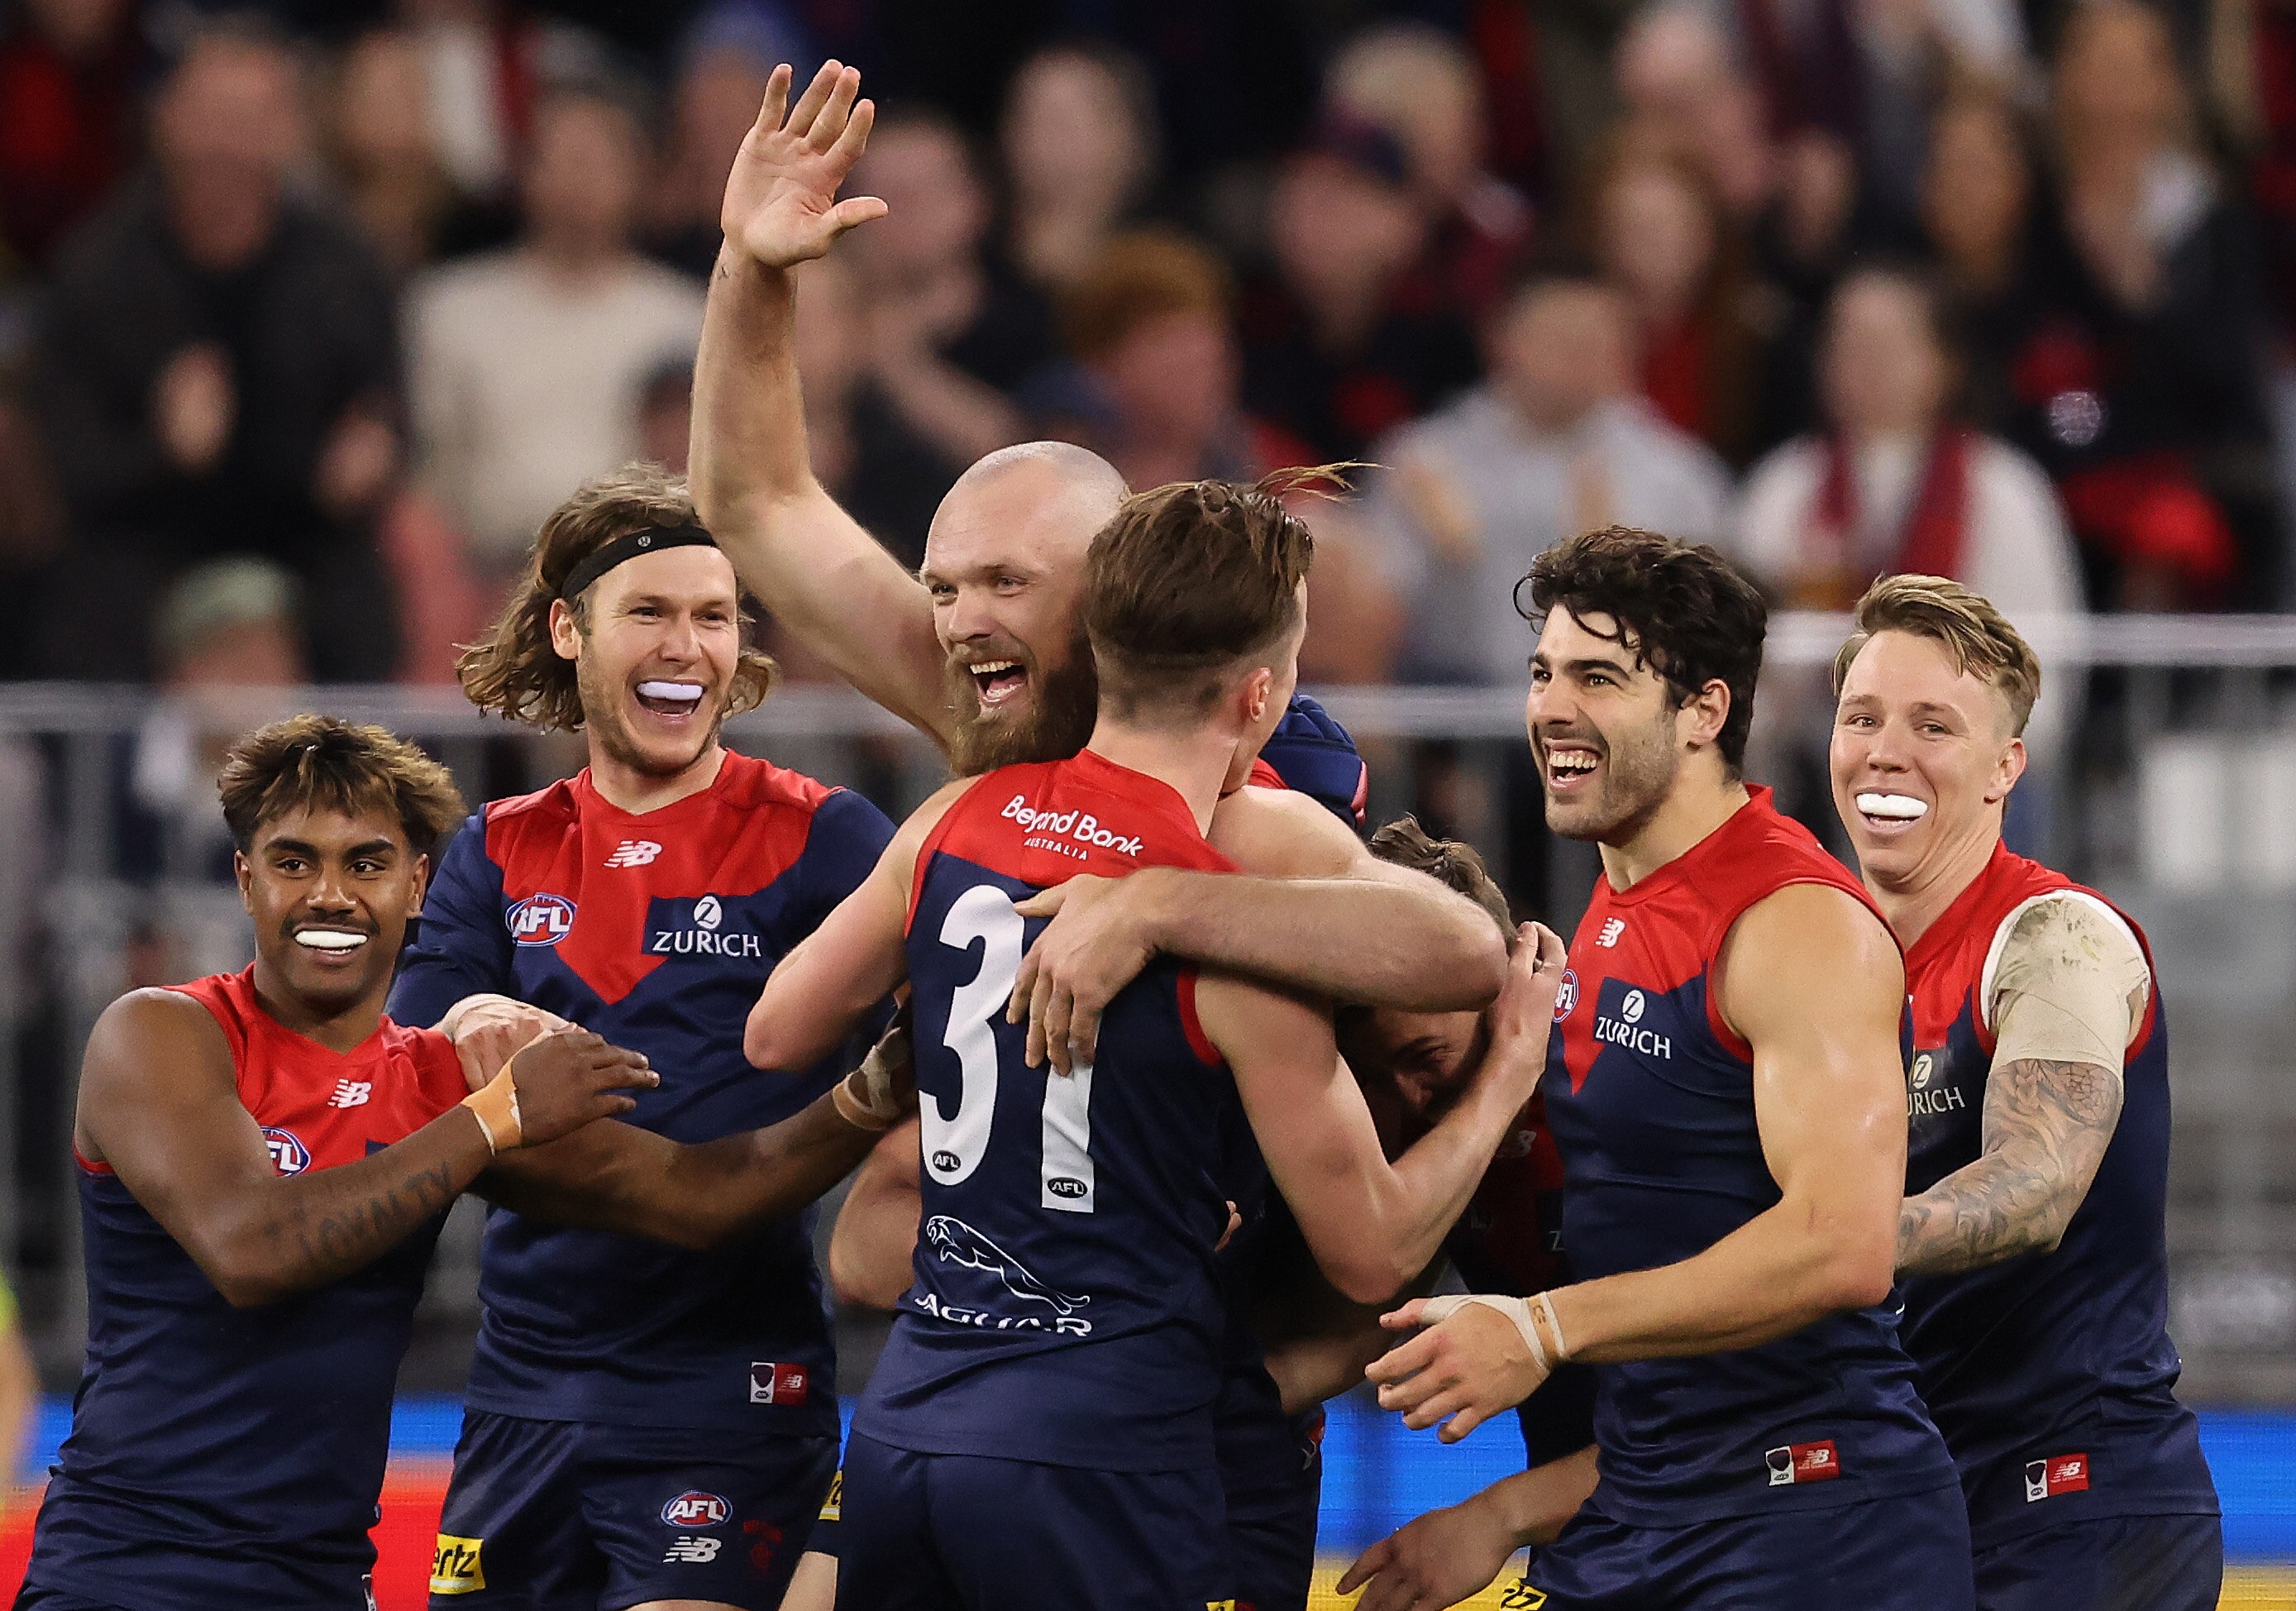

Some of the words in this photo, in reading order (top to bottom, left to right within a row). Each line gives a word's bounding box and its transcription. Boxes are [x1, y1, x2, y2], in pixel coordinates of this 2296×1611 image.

[1072, 814, 1144, 857] Bank
[511, 906, 571, 938] AFL
[652, 930, 762, 958] ZURICH
[1594, 1016, 1672, 1060] ZURICH
[934, 1154, 959, 1169] AFL
[1051, 1180, 1085, 1195] AFL
[666, 1499, 724, 1523] AFL
